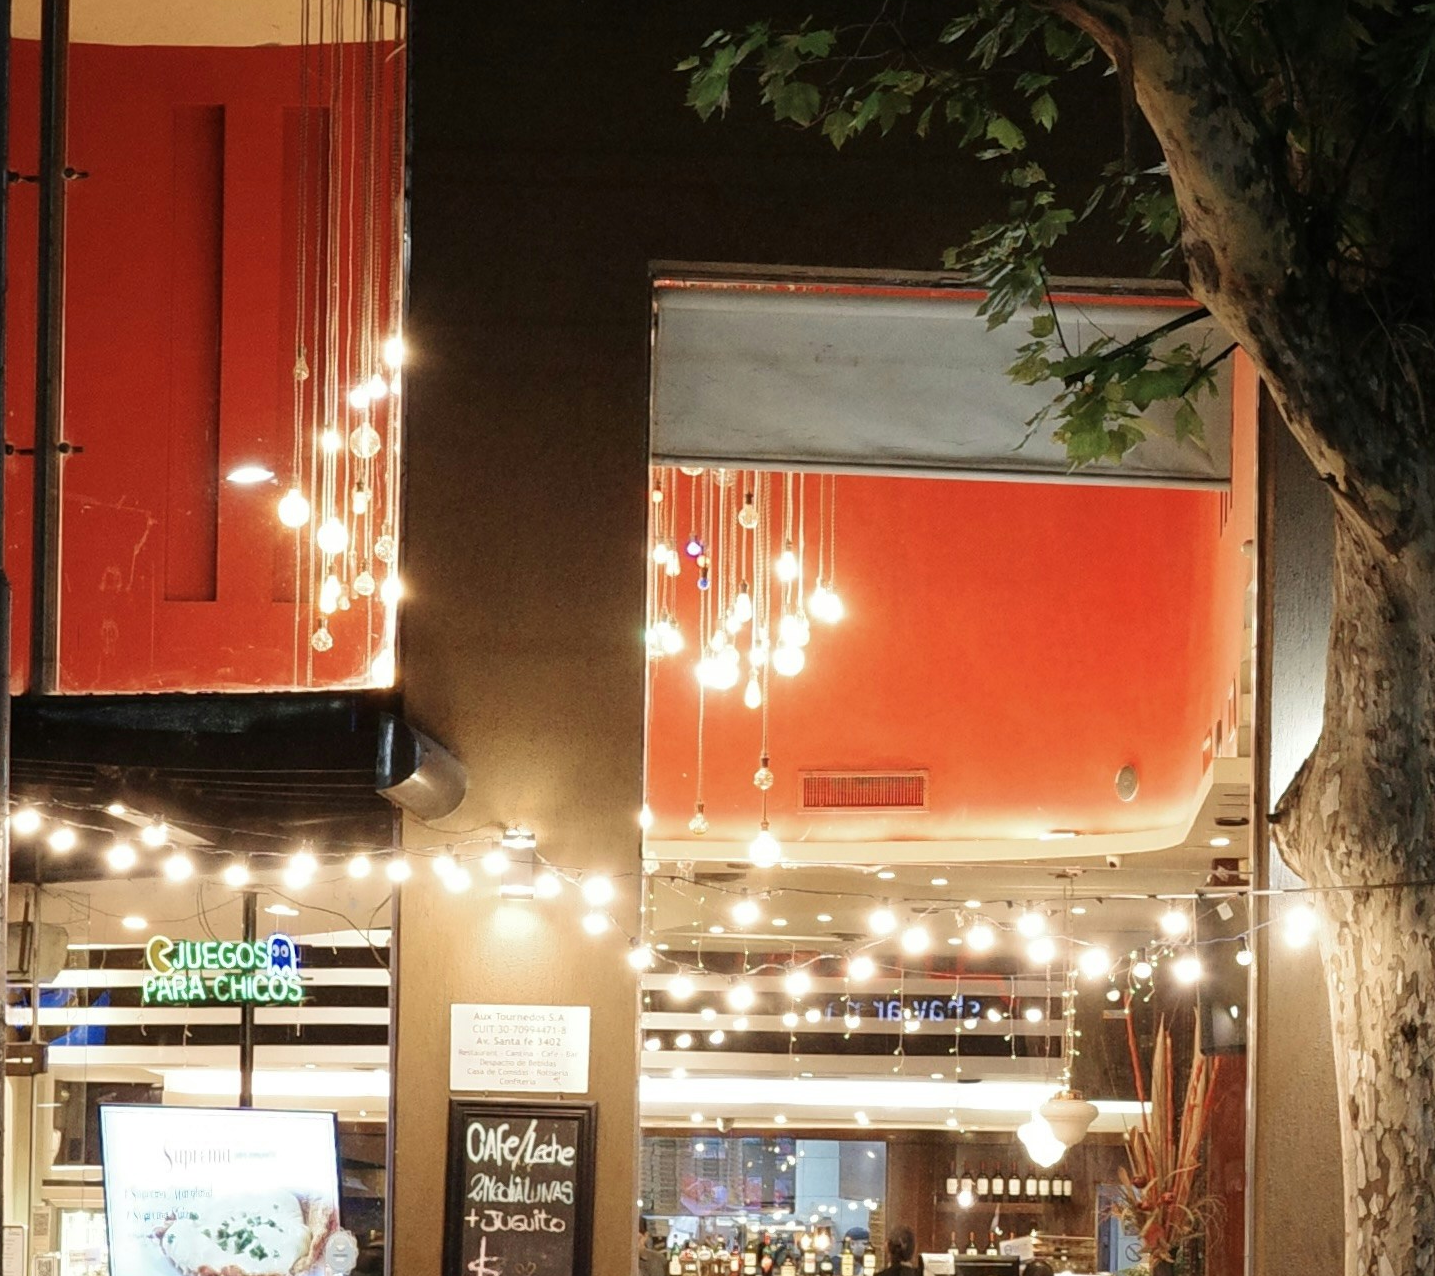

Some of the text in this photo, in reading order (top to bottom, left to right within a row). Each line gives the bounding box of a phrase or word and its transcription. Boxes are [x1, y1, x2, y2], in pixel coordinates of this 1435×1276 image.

[172, 941, 268, 969] JUEGOS
[142, 975, 303, 1003] PARA CHICOS
[473, 1012, 492, 1020] Aux
[496, 1012, 545, 1022] Tournedos
[472, 1025, 495, 1034] CUIT
[494, 1037, 521, 1046] Santa
